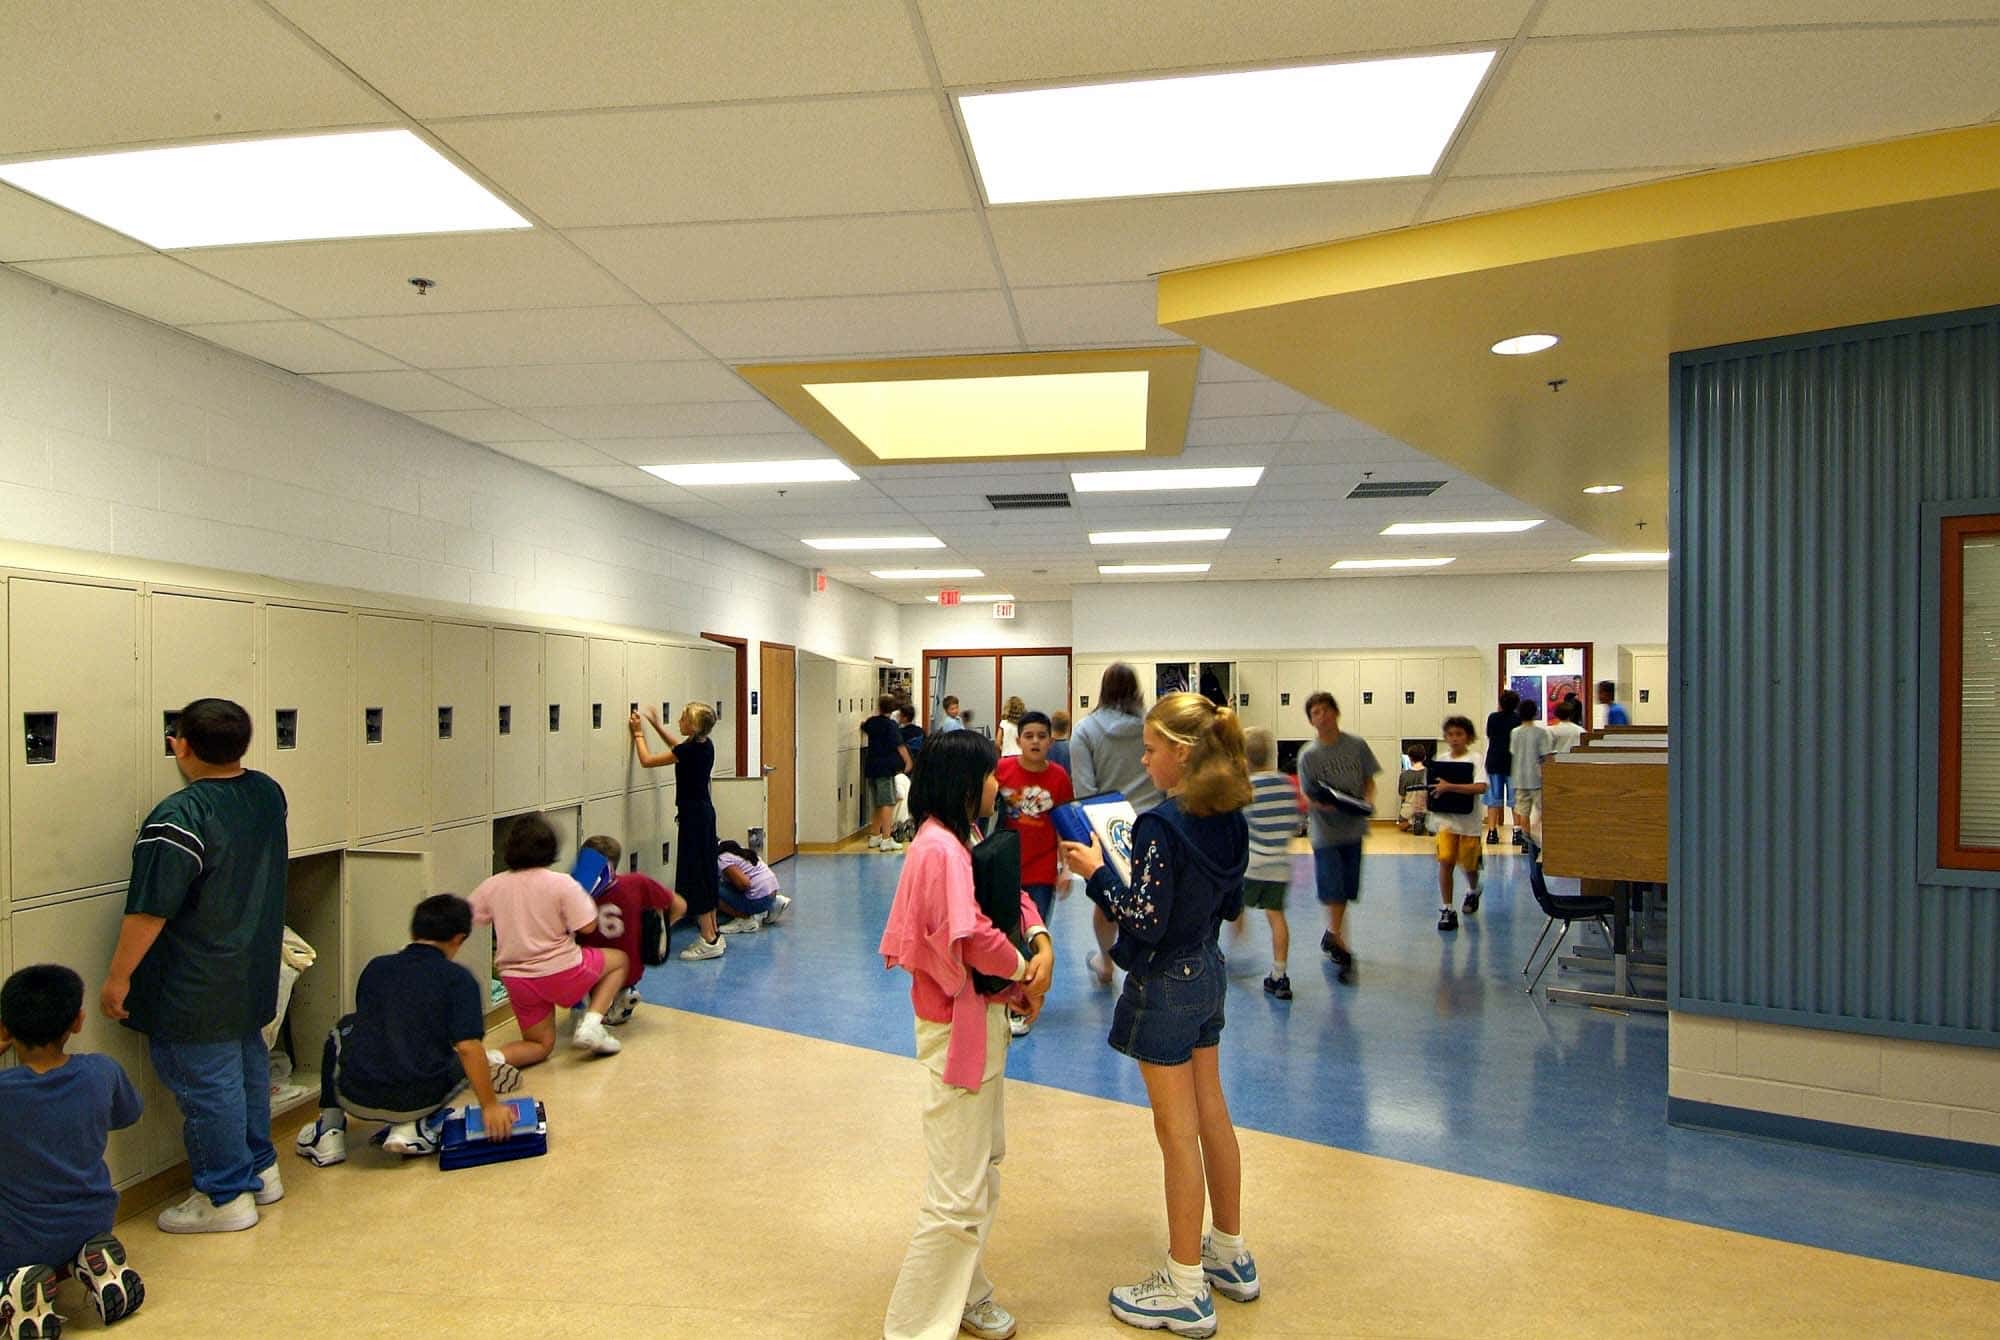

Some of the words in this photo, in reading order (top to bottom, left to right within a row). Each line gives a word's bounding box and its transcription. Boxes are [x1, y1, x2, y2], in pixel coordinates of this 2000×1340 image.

[941, 591, 959, 605] EXIT
[997, 605, 1013, 616] EXIT
[598, 903, 625, 939] 6
